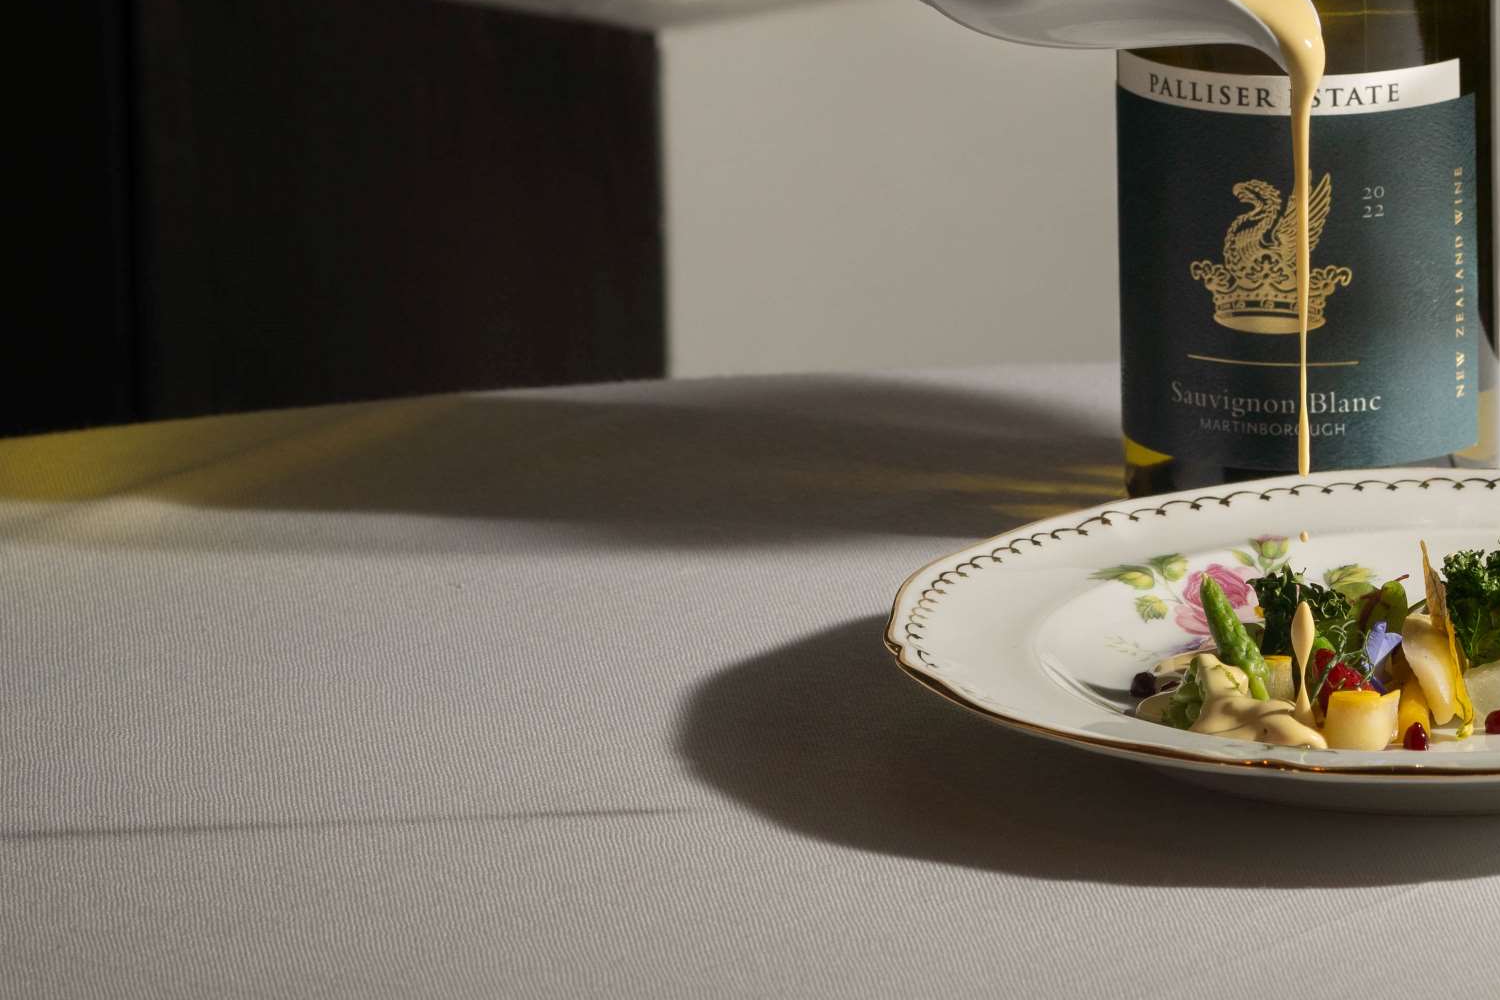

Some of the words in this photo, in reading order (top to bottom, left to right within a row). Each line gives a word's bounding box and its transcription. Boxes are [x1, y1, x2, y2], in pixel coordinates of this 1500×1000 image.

[1149, 72, 1276, 108] PALLISER
[1288, 82, 1400, 108] STATE
[1361, 185, 1385, 200] 20
[1361, 204, 1385, 219] 22
[1453, 166, 1464, 225] WINE
[1454, 235, 1465, 338] ZEALAND
[1455, 351, 1465, 398] NEW
[1170, 380, 1295, 418] Sauvignon
[1309, 391, 1382, 414] Blanc
